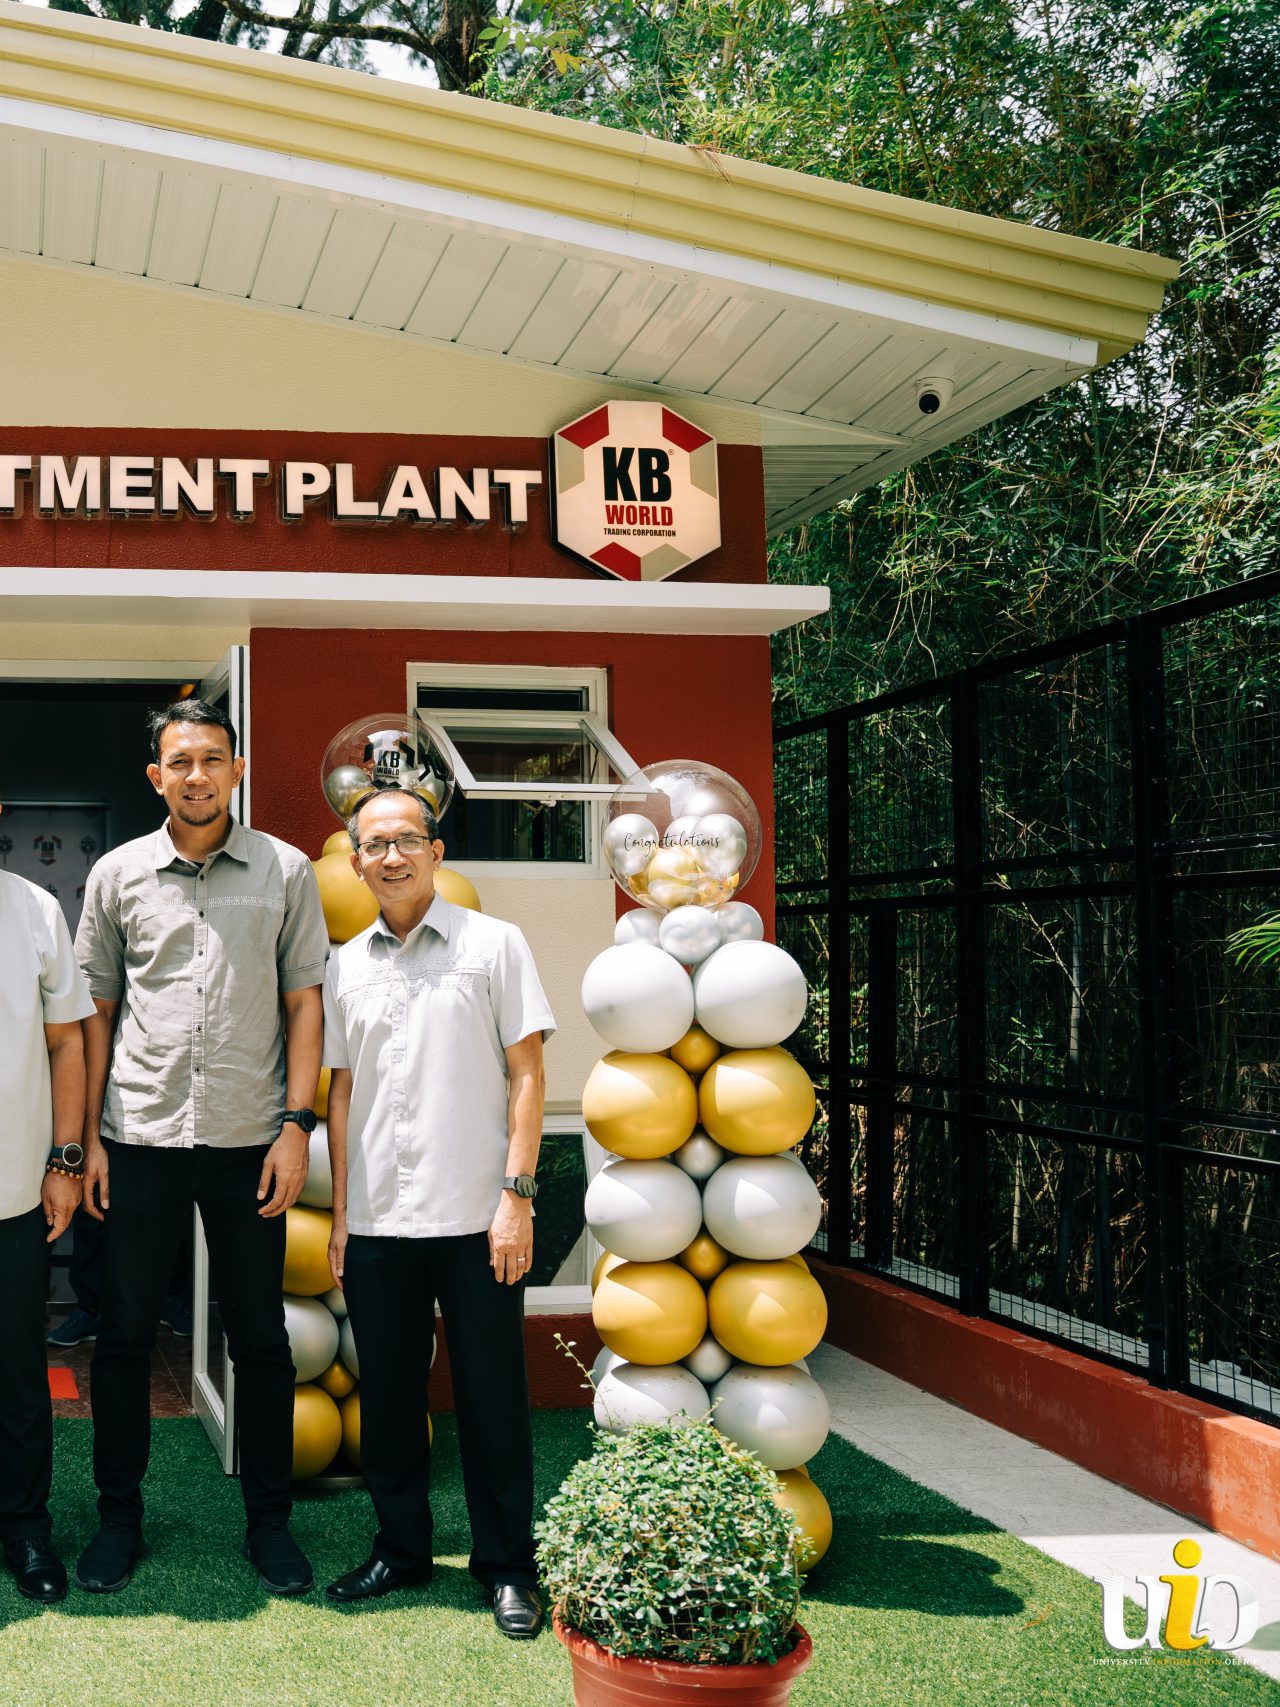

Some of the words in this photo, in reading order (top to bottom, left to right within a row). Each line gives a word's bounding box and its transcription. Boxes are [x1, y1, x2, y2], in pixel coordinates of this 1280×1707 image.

[602, 446, 672, 502] KB
[284, 461, 543, 522] PLANT
[605, 504, 674, 526] WORLD
[603, 527, 632, 536] TRADING
[632, 528, 677, 537] CORPORATION
[378, 750, 400, 767] KB
[376, 767, 400, 775] WORLD
[624, 830, 720, 857] Congratulations
